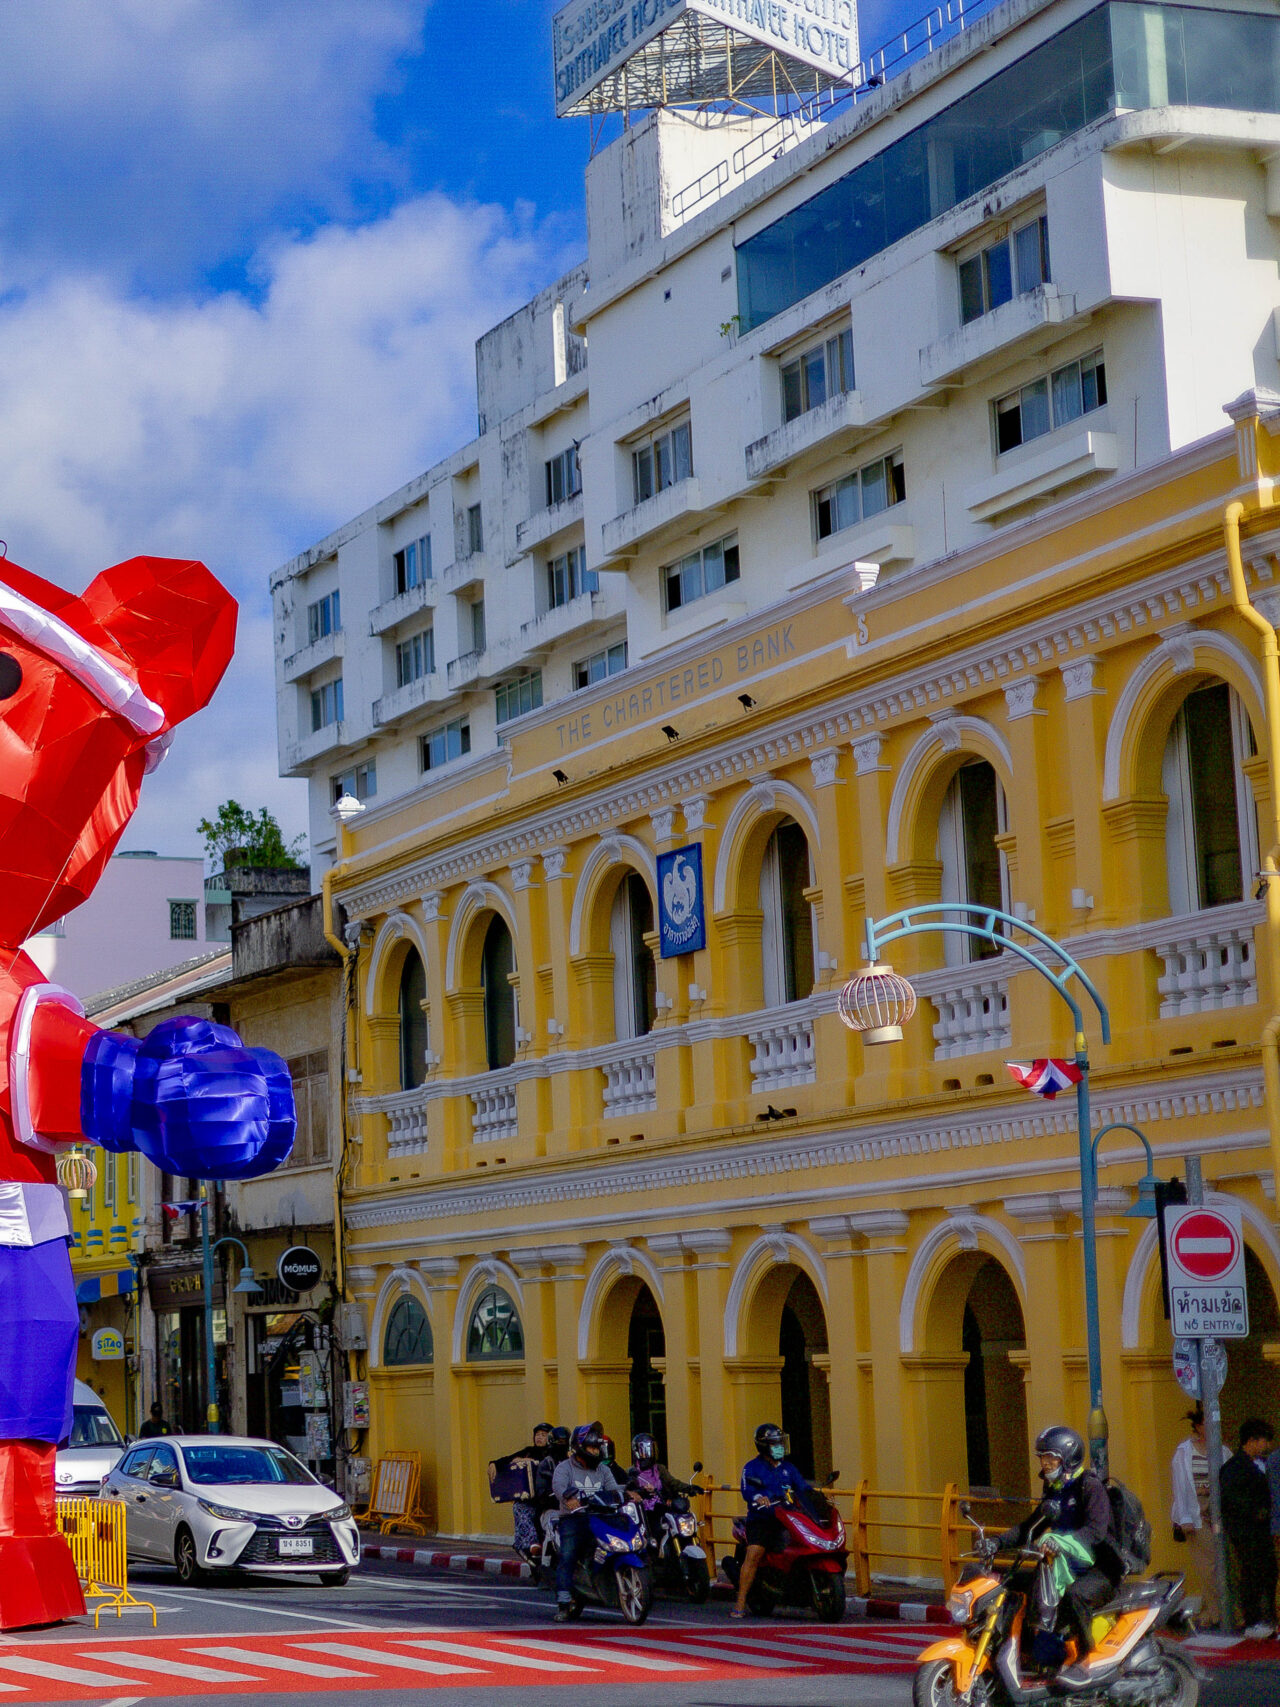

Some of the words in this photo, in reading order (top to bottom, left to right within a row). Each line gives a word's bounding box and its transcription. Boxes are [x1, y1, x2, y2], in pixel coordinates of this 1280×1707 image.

[794, 13, 852, 71] HOTEL
[556, 713, 592, 749] THE
[602, 657, 724, 728] CHARTERED
[736, 623, 796, 673] BANK
[1184, 1319, 1199, 1331] NO
[1203, 1320, 1236, 1330] ENTRY
